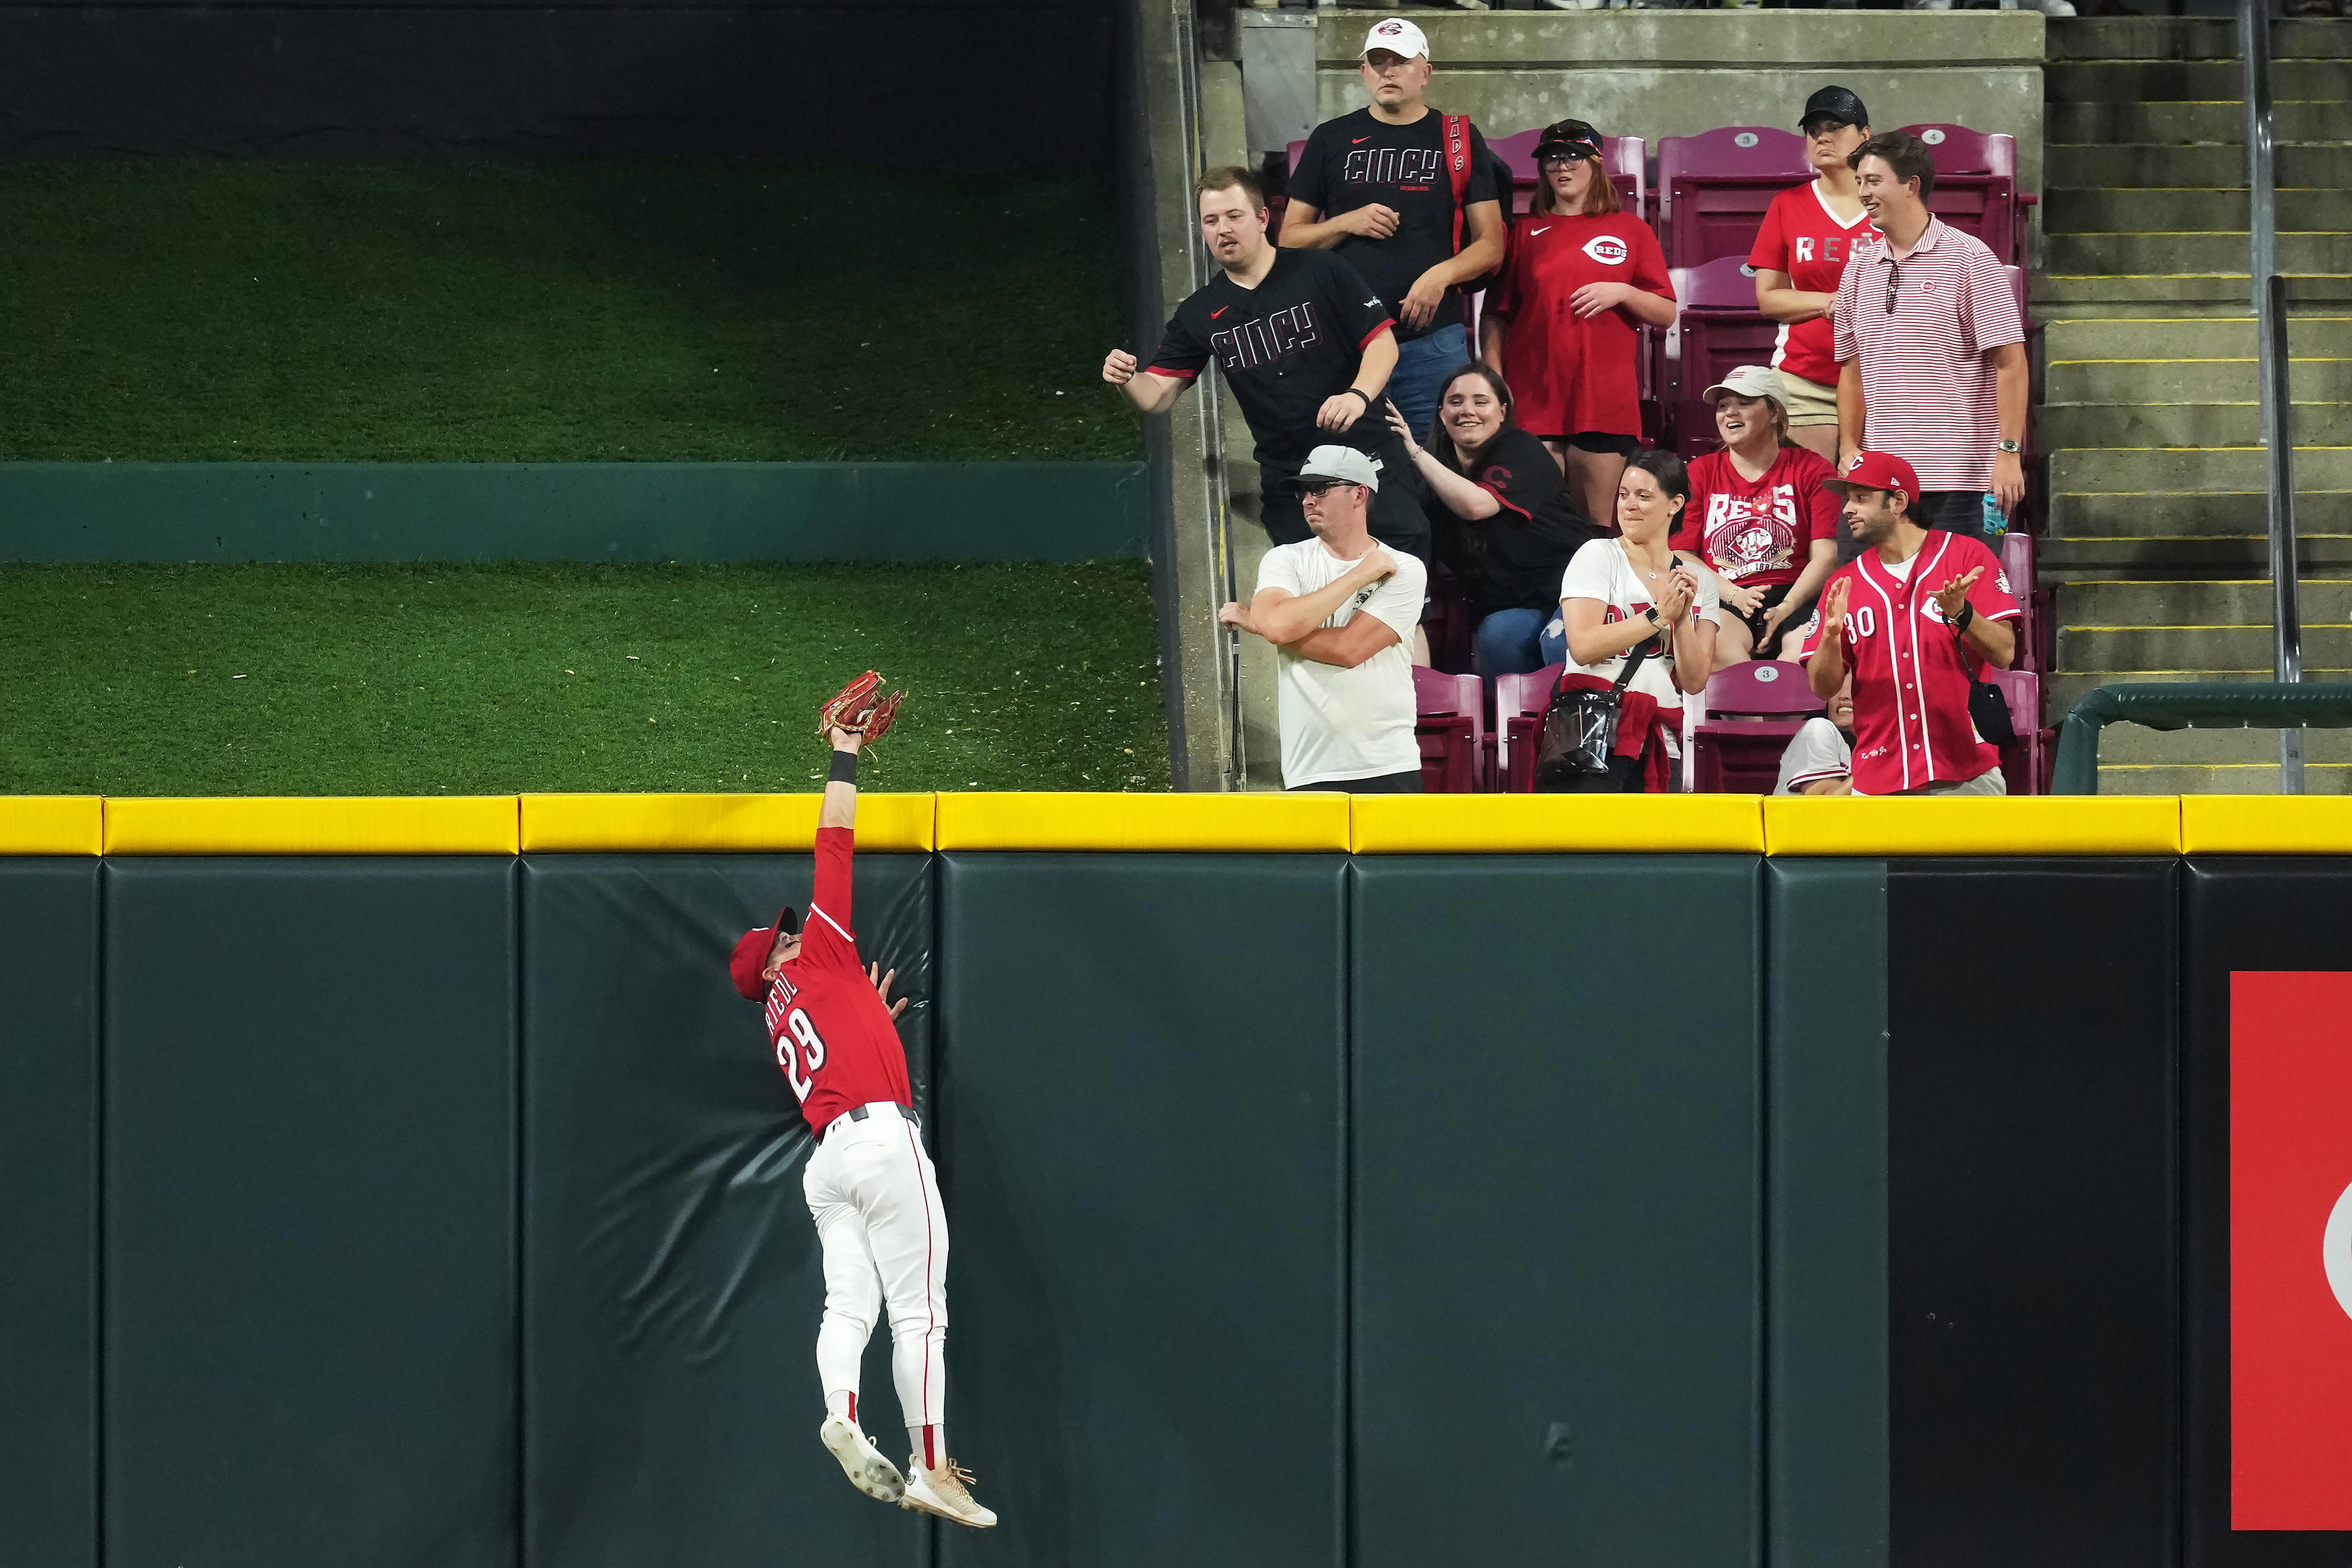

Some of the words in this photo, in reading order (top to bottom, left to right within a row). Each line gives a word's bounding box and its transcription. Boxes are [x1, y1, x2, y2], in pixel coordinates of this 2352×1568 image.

[1343, 148, 1442, 184] CINCY
[1595, 245, 1628, 258] REDS
[1482, 465, 1513, 488] C
[1849, 455, 1864, 470] C
[1704, 483, 1797, 540] RES
[1843, 606, 1876, 645] 30
[1763, 670, 1770, 678] 3
[765, 971, 799, 1036] RIEDL
[776, 1008, 828, 1104] 29
